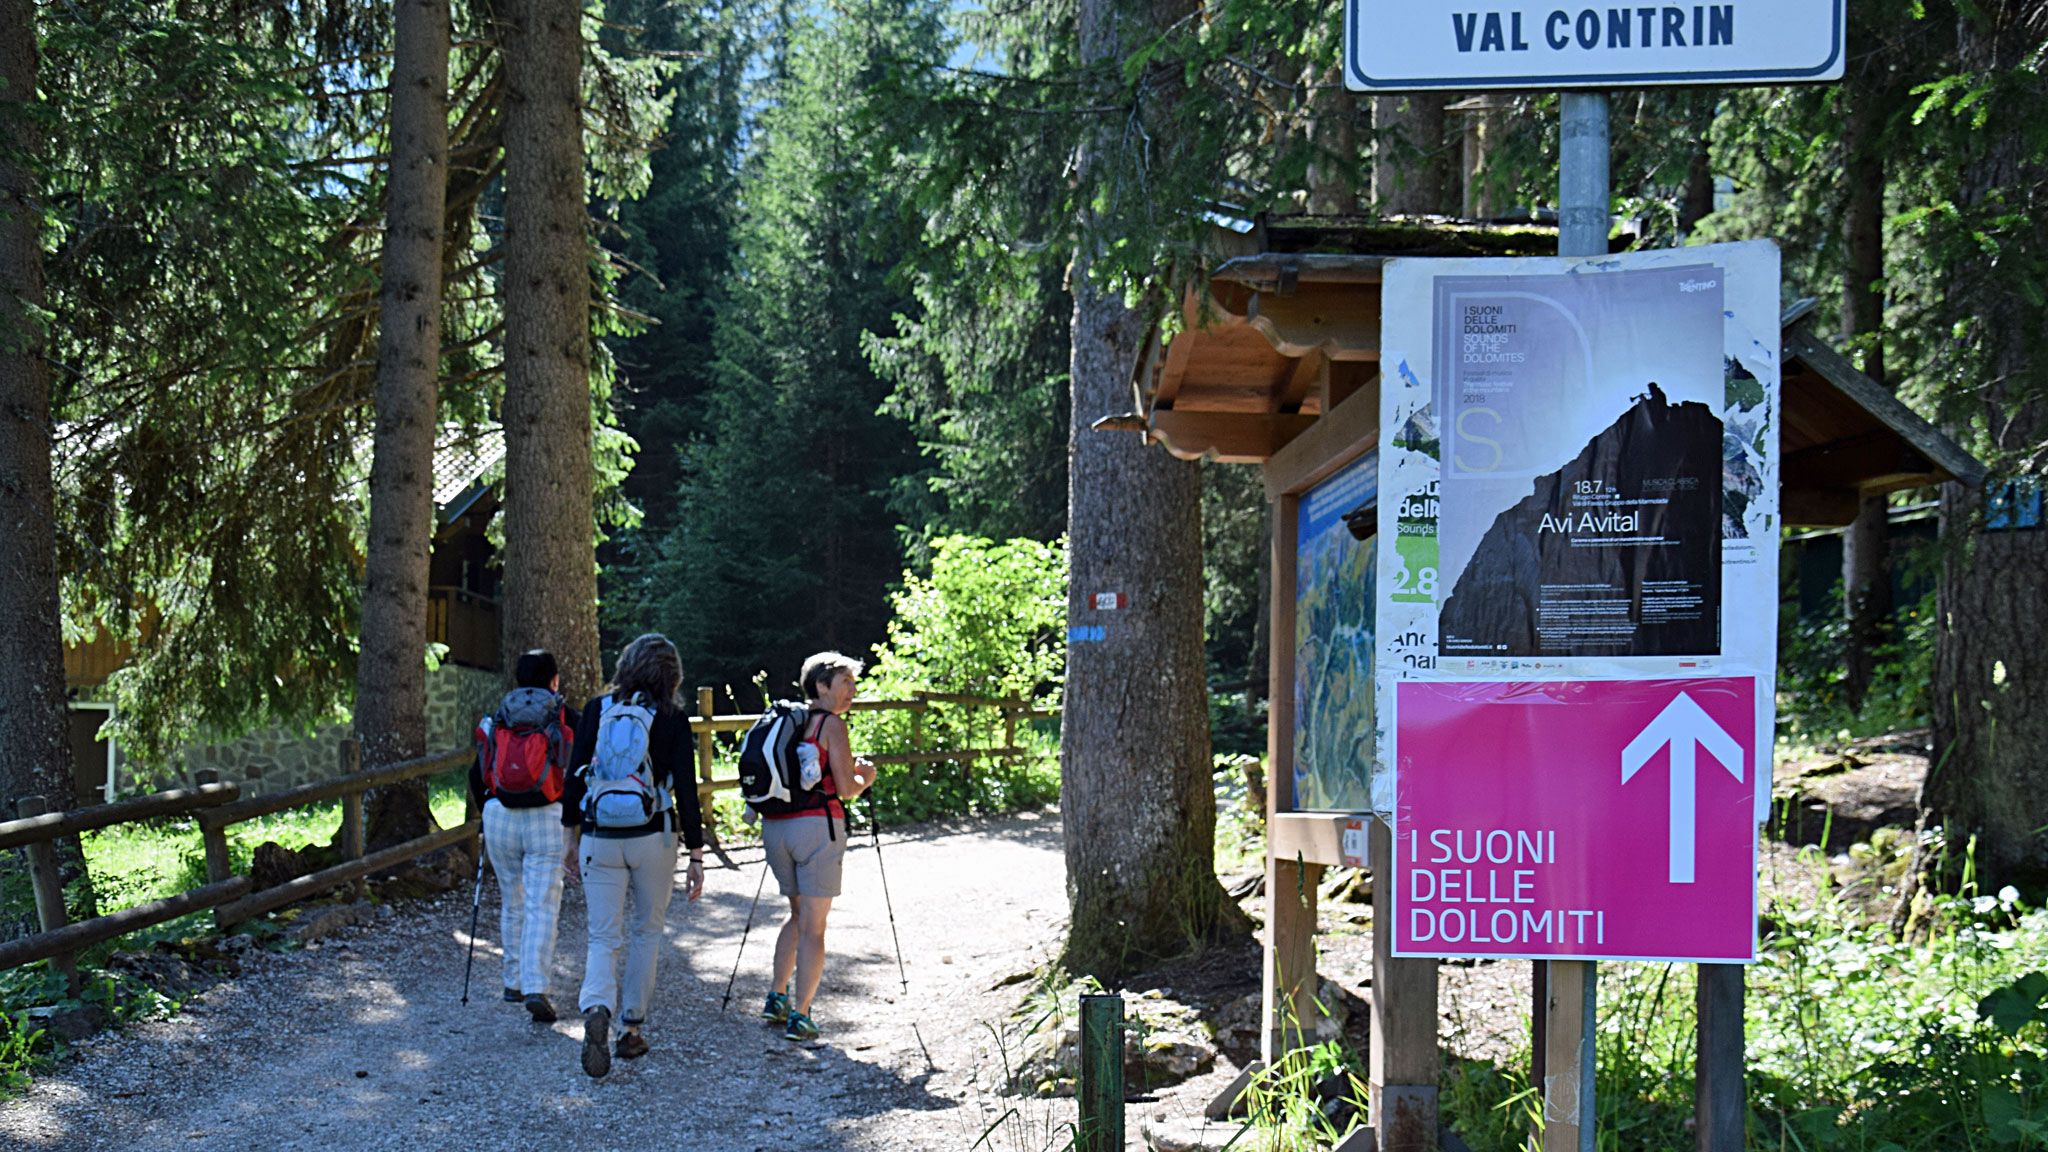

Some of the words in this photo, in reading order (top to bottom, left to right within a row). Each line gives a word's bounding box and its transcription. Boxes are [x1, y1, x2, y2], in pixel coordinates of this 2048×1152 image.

[1452, 12, 1529, 52] VAL
[1545, 5, 1734, 50] CONTRIN
[1464, 306, 1468, 315] I
[1469, 306, 1503, 315] SUONI
[1464, 316, 1498, 324] DELLE
[1464, 325, 1517, 334] DOLOMITI
[1463, 334, 1509, 344] SOUNDS
[1463, 344, 1477, 353] OF
[1479, 344, 1501, 353] THE
[1463, 353, 1525, 363] DOLOMITES
[1463, 394, 1486, 404] 2018
[1455, 407, 1503, 472] S
[1574, 480, 1603, 494] 18.7
[1397, 522, 1434, 535] Sounds
[1538, 512, 1573, 533] Avi
[1577, 511, 1639, 533] Avital
[1411, 829, 1417, 862] I
[1430, 829, 1555, 864] SUONI
[1411, 869, 1535, 903] DELLE
[1411, 908, 1604, 944] DOLOMITI
